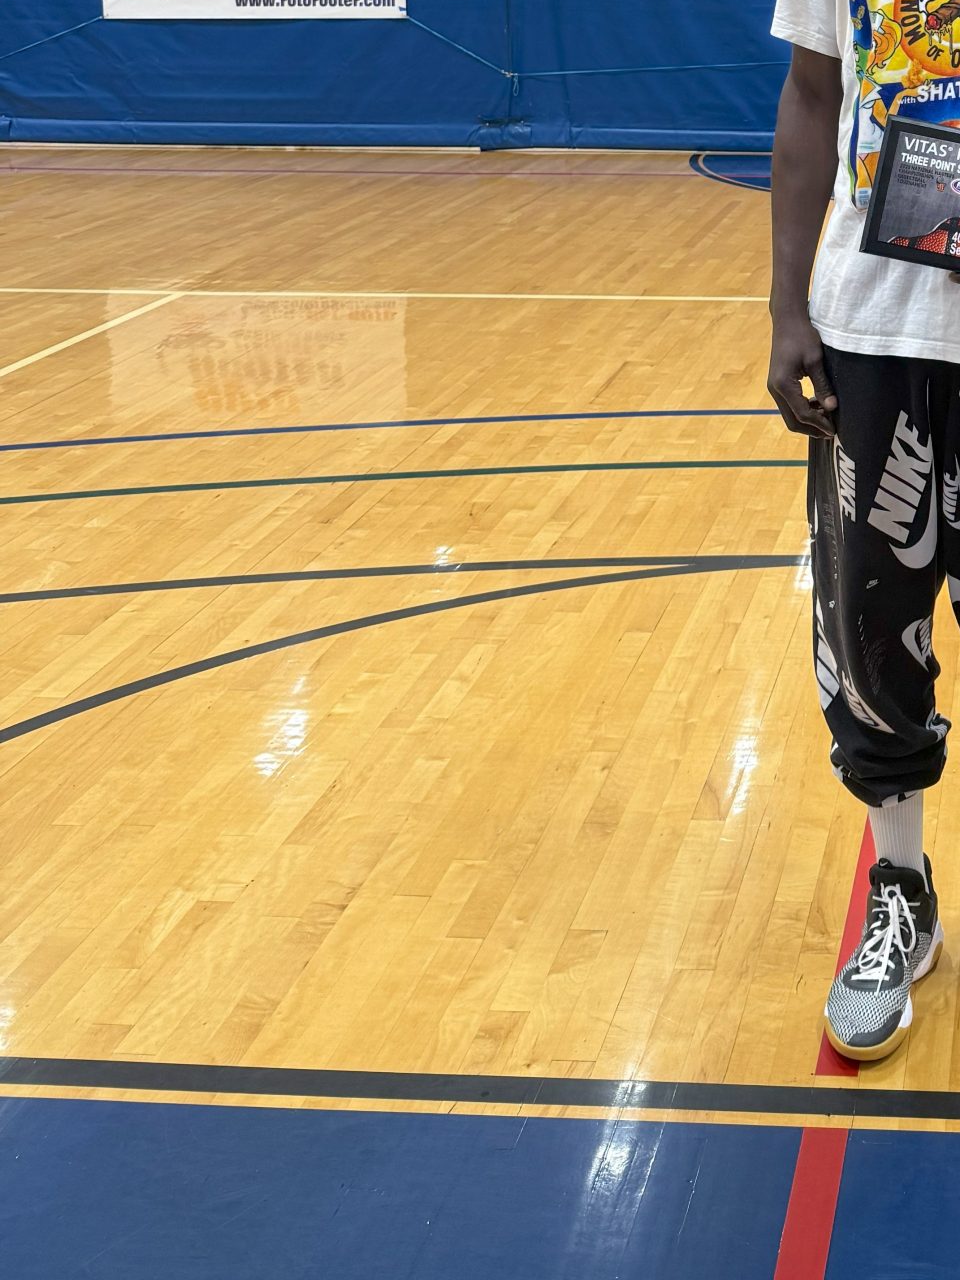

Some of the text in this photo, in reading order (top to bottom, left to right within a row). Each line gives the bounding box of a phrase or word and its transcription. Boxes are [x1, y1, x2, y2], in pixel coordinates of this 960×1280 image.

[926, 45, 944, 62] OF
[897, 96, 916, 105] with
[901, 153, 928, 167] THREE
[930, 158, 956, 174] POINT
[838, 448, 856, 522] NIKE
[867, 410, 932, 544] NIKE
